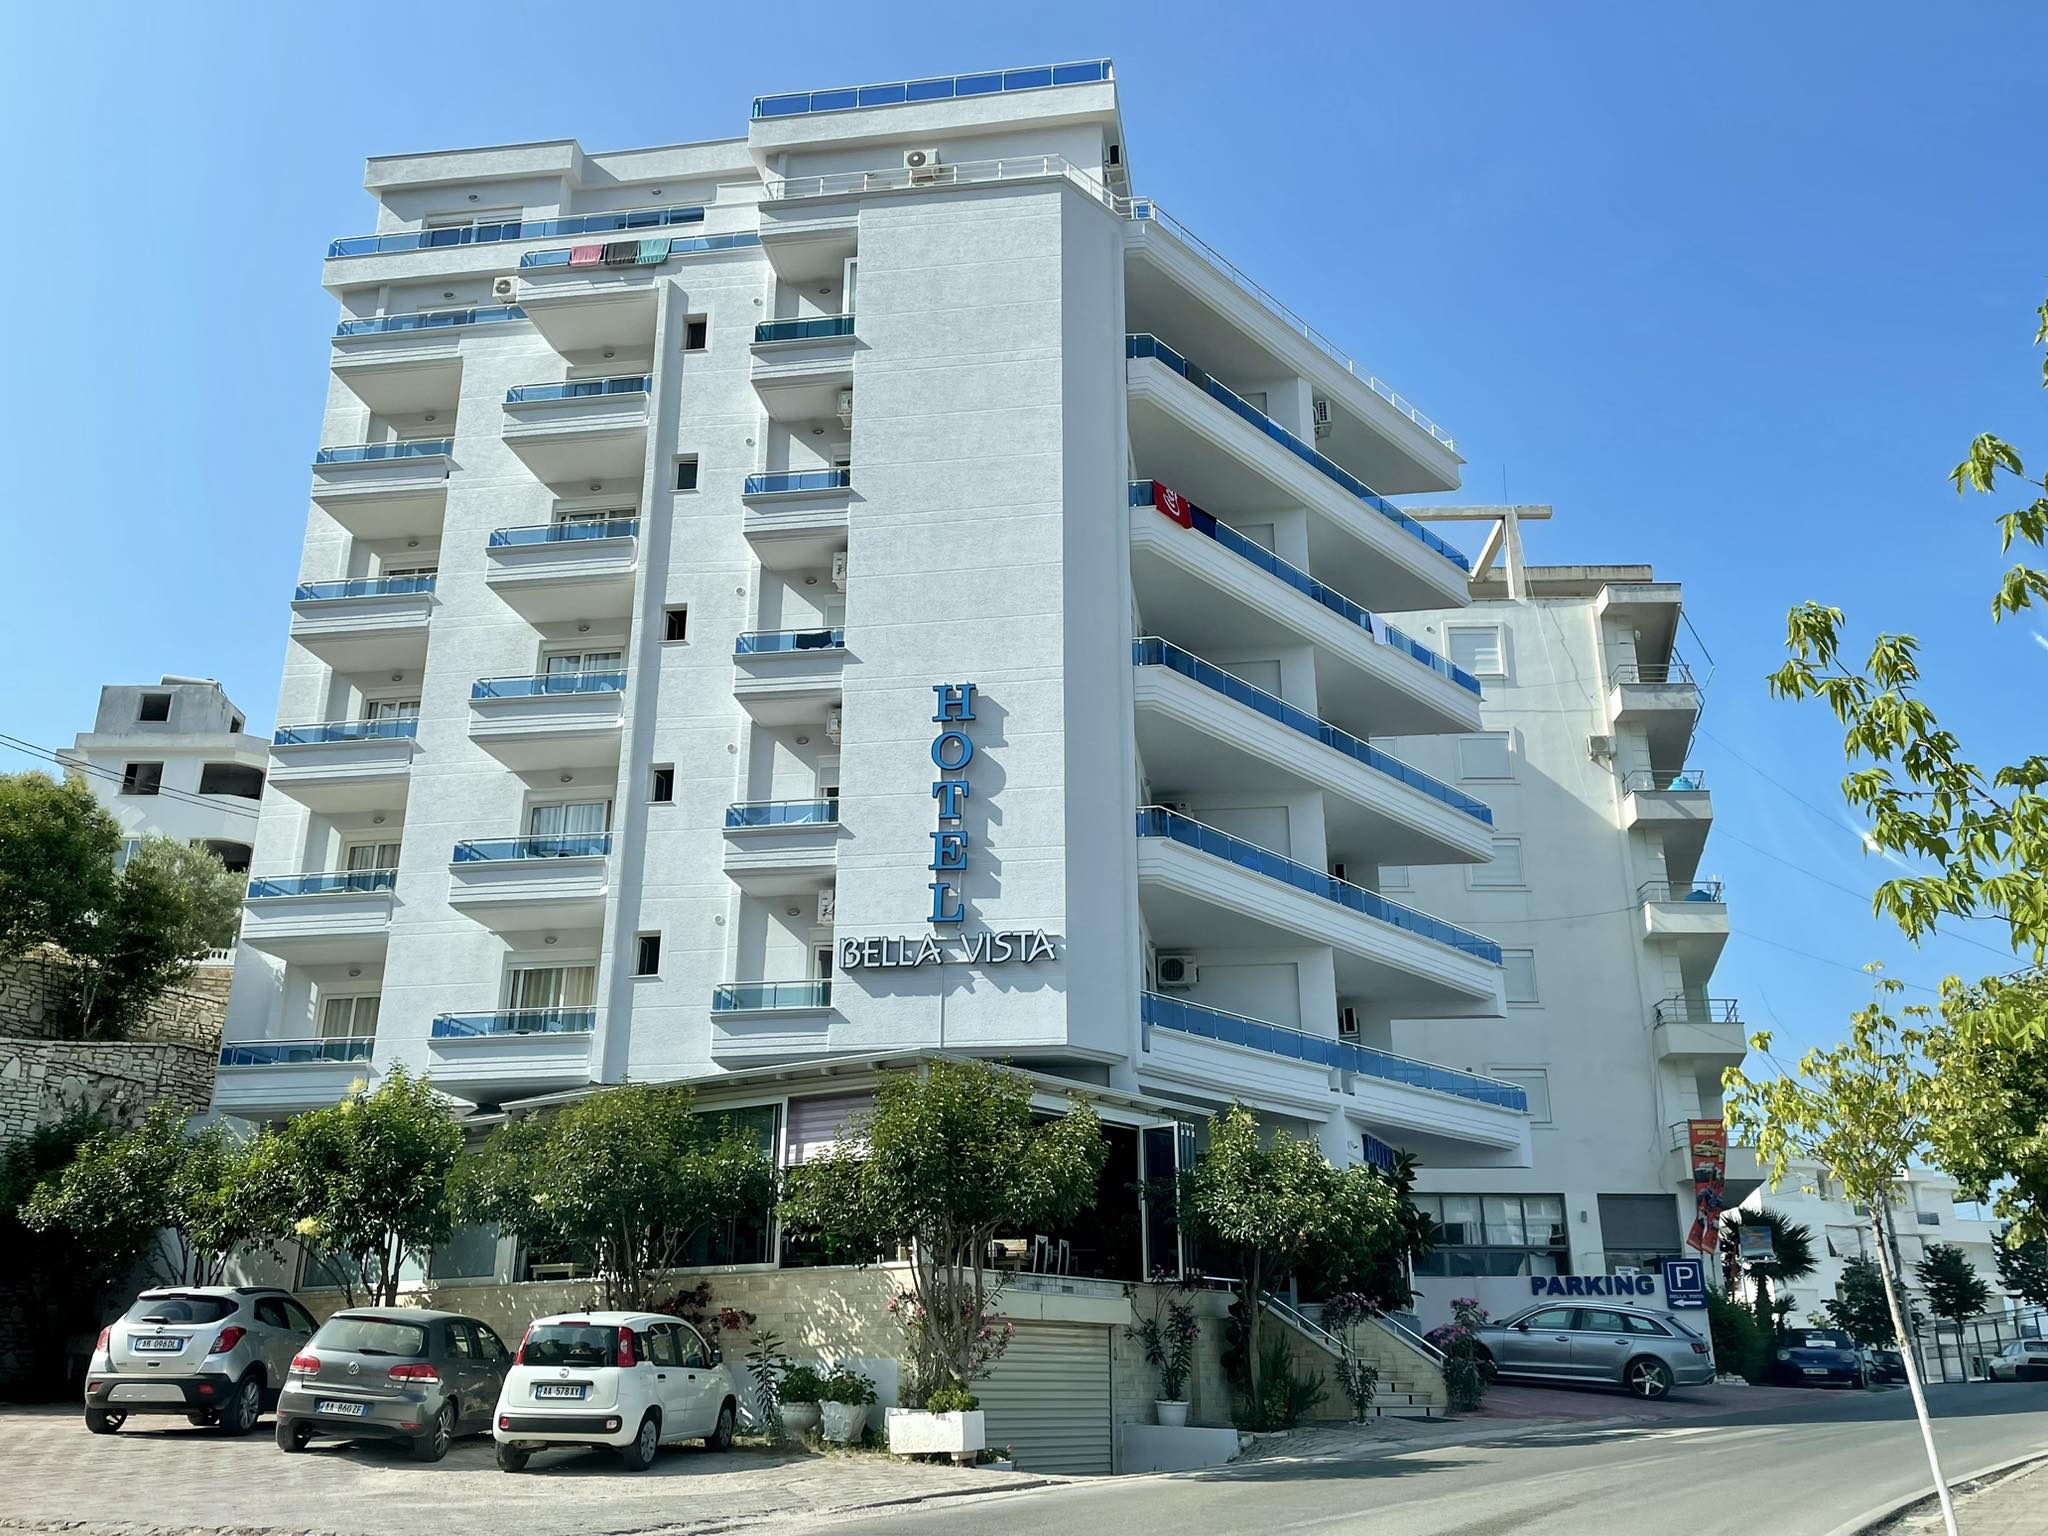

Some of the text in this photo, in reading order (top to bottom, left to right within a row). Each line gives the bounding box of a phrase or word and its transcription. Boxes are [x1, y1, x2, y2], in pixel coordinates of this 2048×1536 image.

[927, 683, 977, 923] HOTEL
[839, 929, 1056, 969] BELLA VISTA
[1531, 1275, 1655, 1297] PARKING
[1675, 1266, 1694, 1288] P
